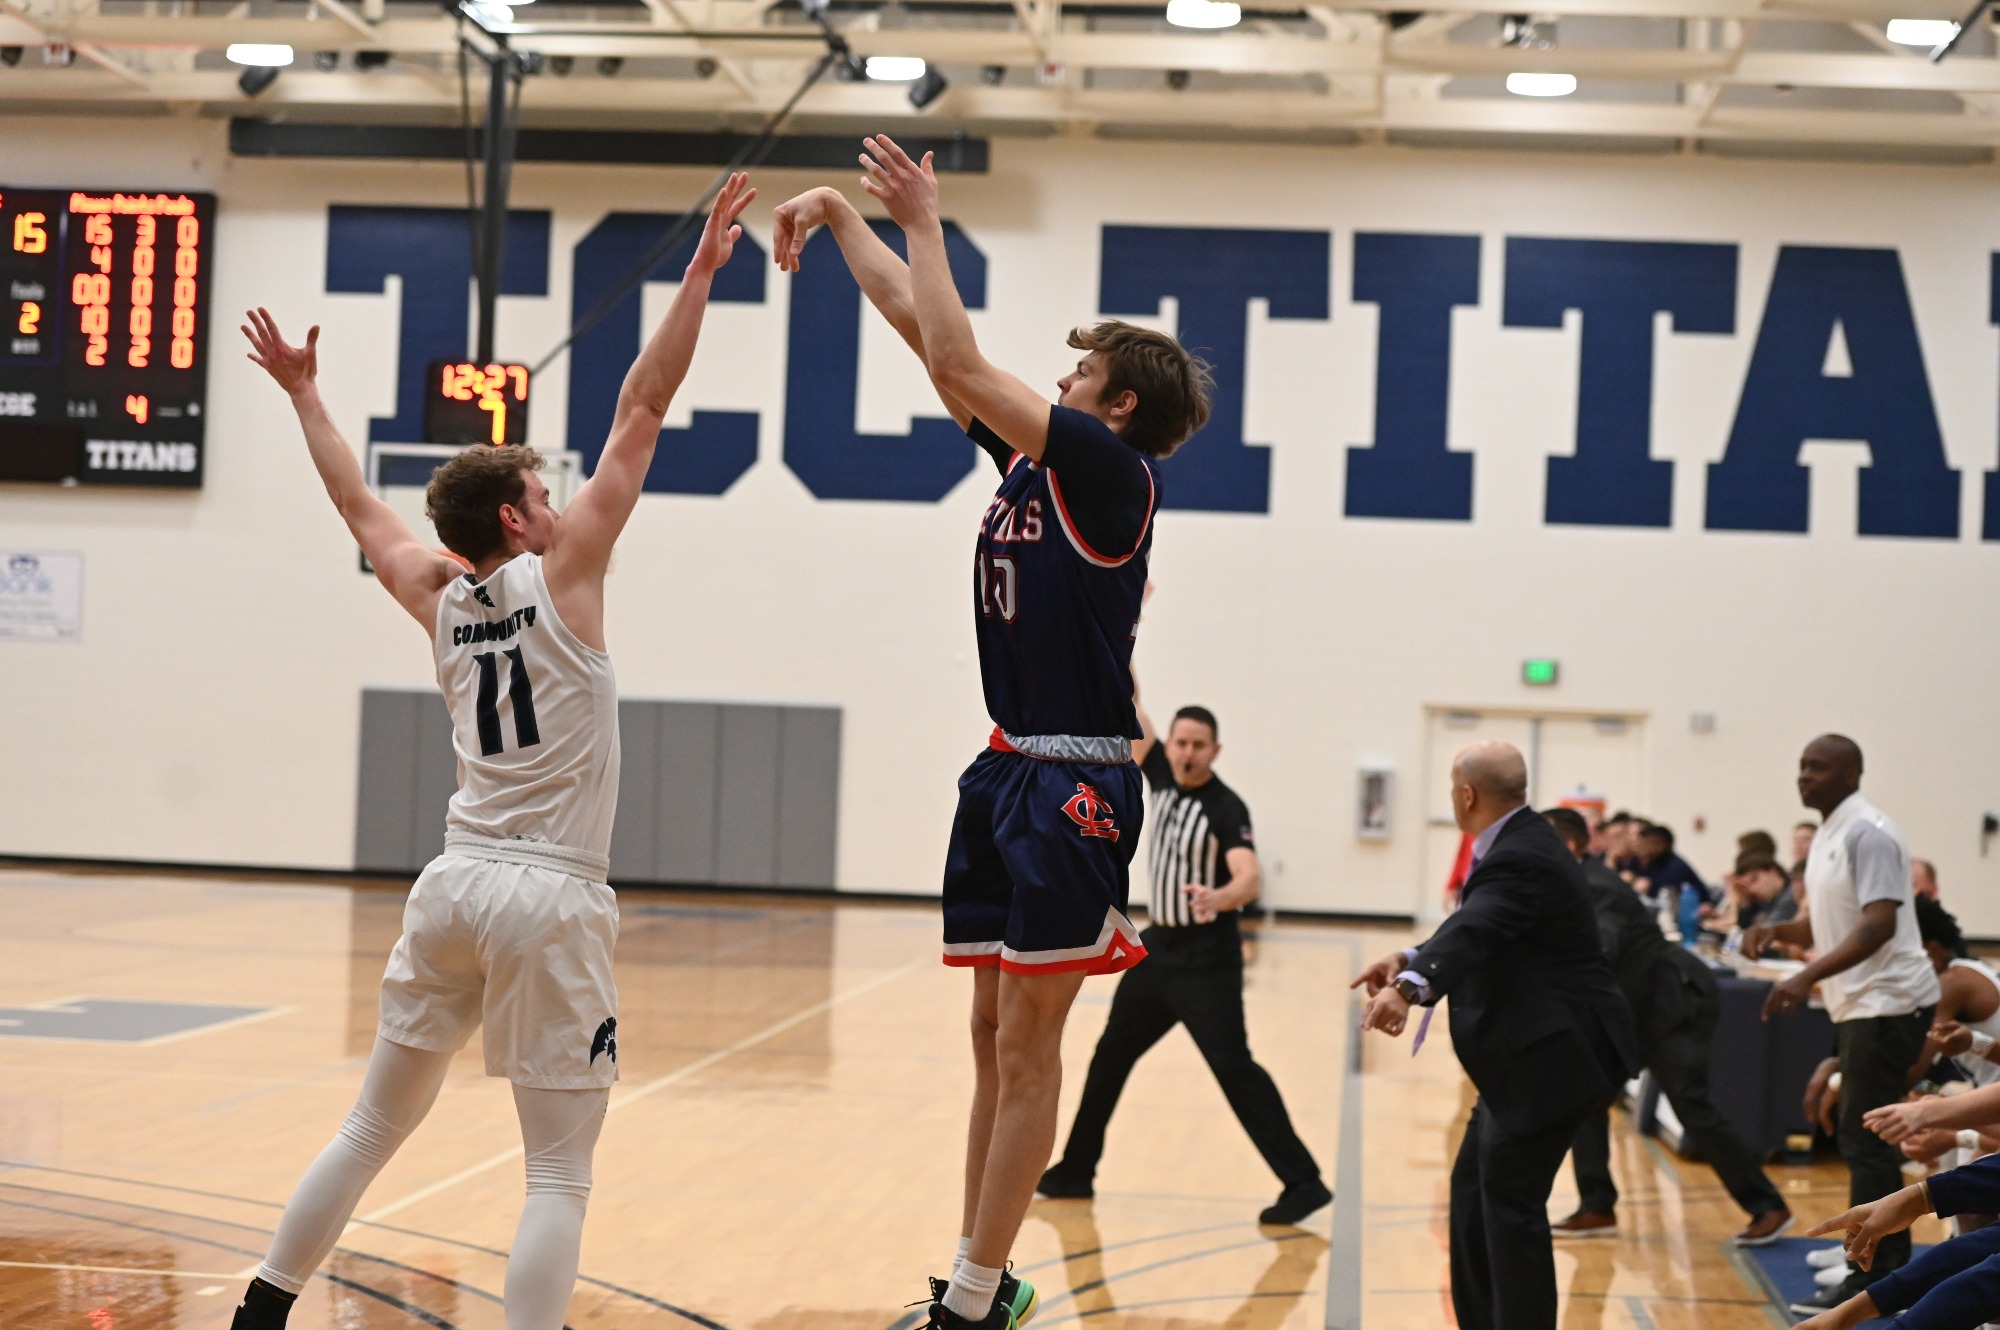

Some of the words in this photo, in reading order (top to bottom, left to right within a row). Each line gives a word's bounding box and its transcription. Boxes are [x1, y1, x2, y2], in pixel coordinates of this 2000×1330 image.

[13, 212, 47, 253] 15
[86, 214, 113, 246] 15
[136, 214, 156, 246] 3
[177, 215, 199, 248] 0
[91, 245, 112, 274] 4
[133, 245, 155, 277] 0
[175, 246, 198, 278] 0
[131, 275, 153, 307] 0
[174, 276, 196, 308] 0
[19, 301, 41, 334] 2
[130, 305, 152, 337] 0
[172, 306, 195, 338] 0
[86, 334, 108, 366] 2
[128, 335, 151, 368] 2
[171, 337, 193, 369] 0
[323, 204, 987, 503] TCC
[1098, 224, 2000, 543] TITA
[442, 363, 528, 401] 12:27
[125, 394, 149, 425] 4
[478, 398, 507, 446] 7
[85, 438, 197, 472] TITANS
[452, 605, 537, 647] COMMUNITY
[472, 643, 541, 757] 11
